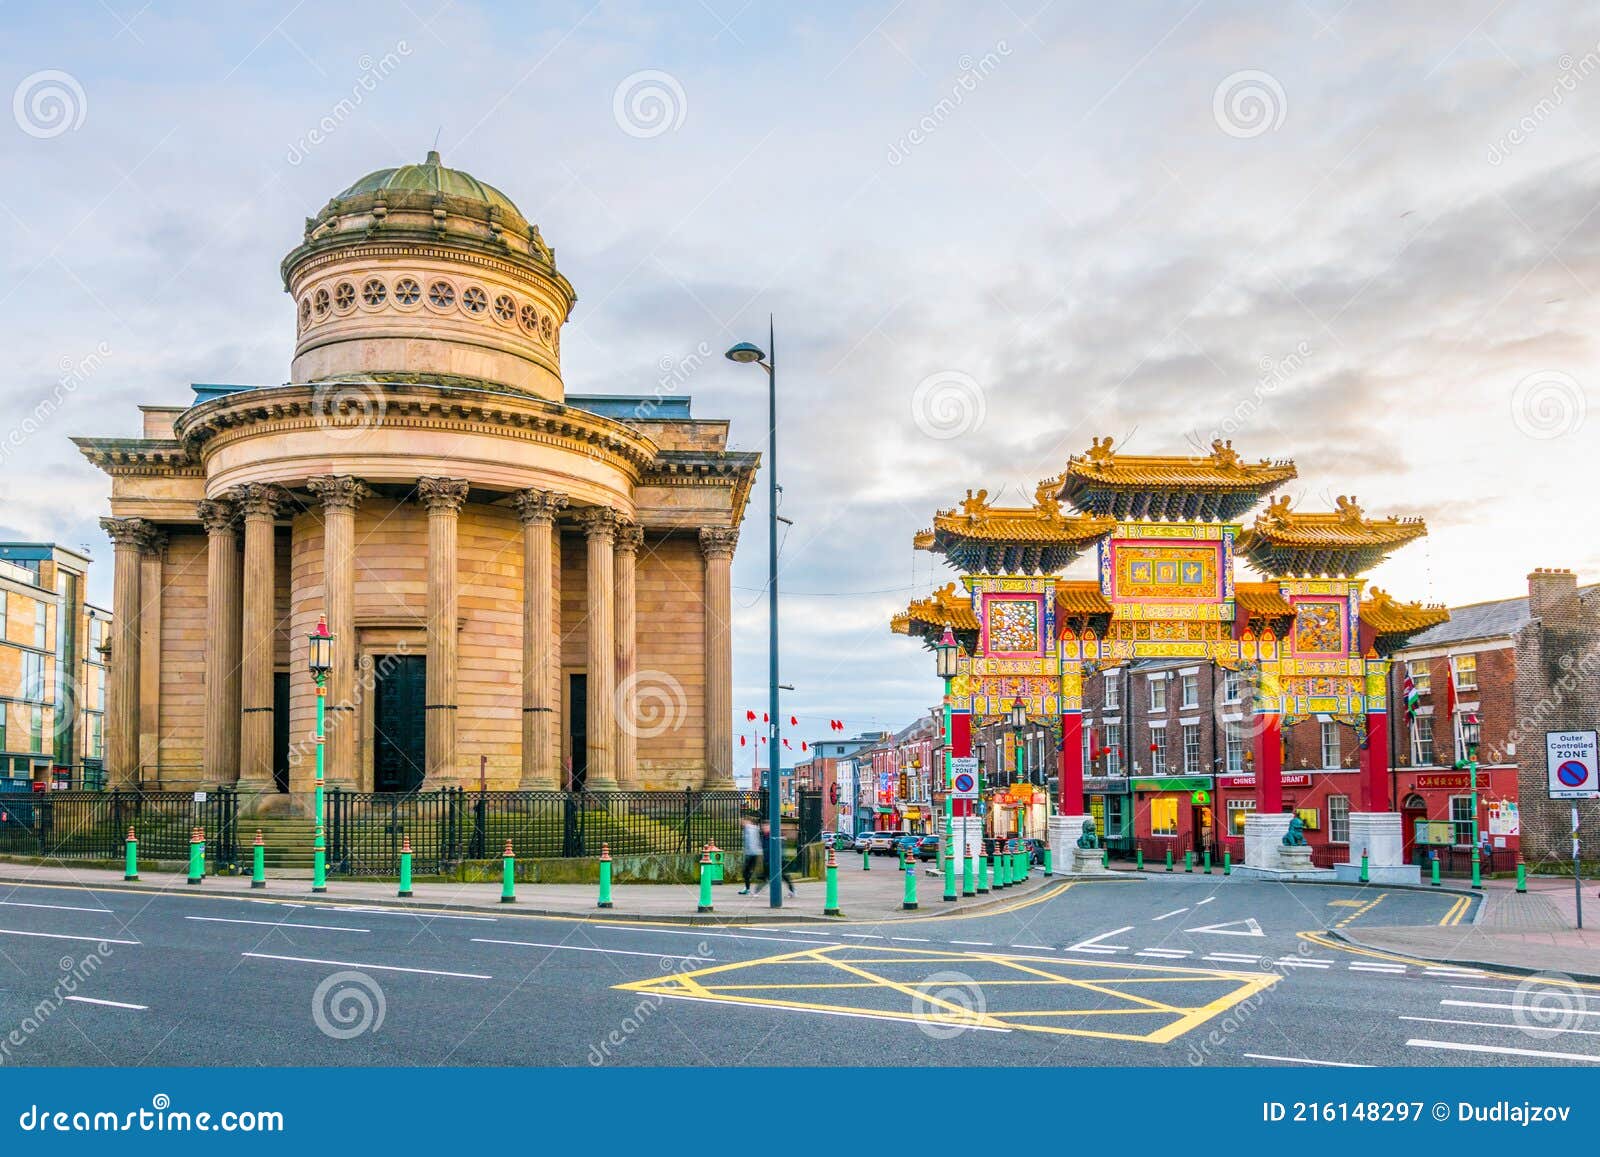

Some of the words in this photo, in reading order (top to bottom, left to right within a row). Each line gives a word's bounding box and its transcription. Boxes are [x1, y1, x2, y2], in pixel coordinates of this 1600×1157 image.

[1550, 742, 1593, 750] Controlled
[1557, 750, 1588, 758] ZONE
[1233, 776, 1256, 785] CHINES
